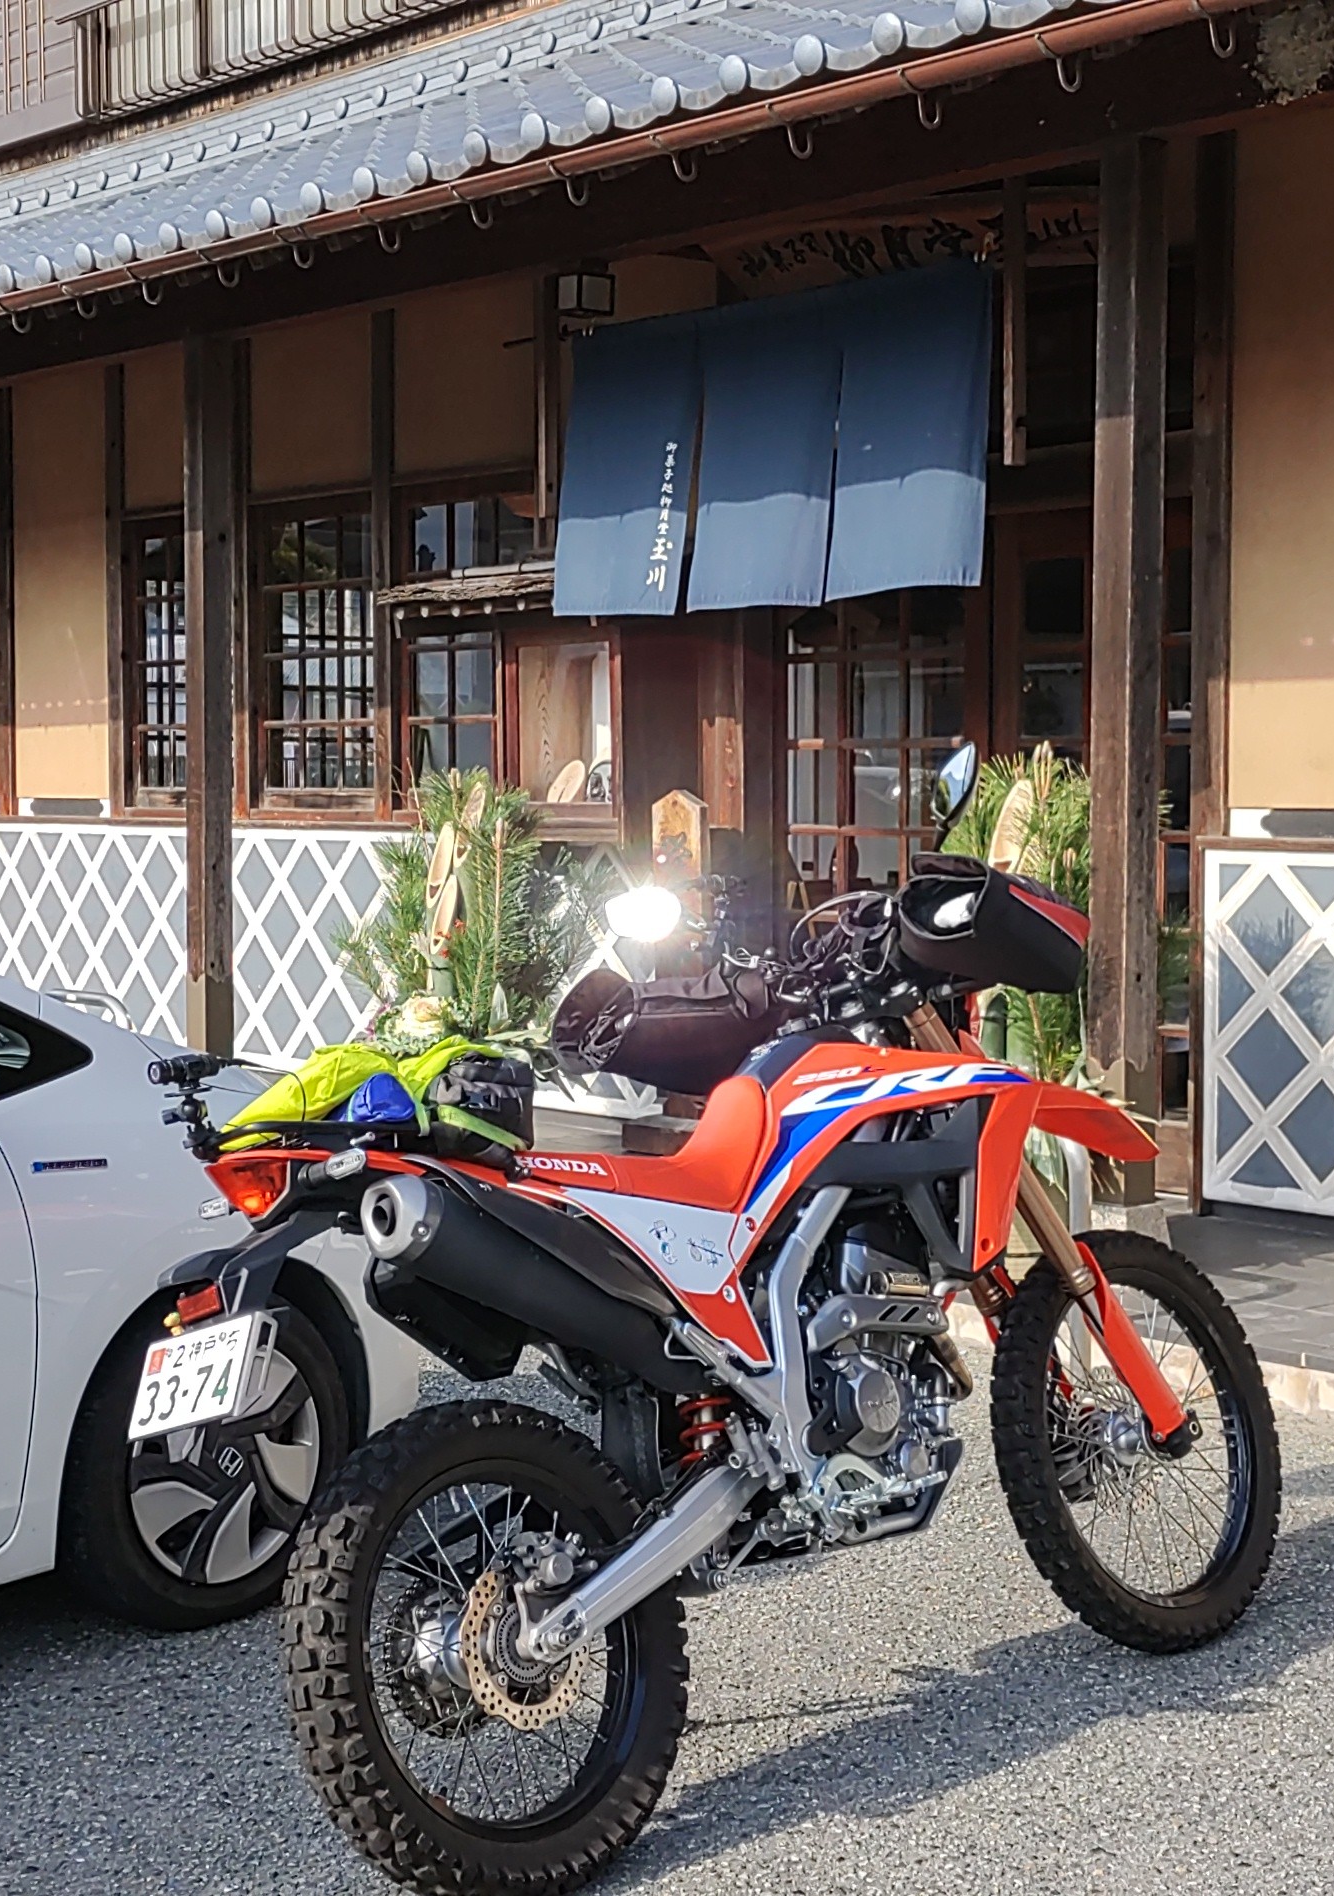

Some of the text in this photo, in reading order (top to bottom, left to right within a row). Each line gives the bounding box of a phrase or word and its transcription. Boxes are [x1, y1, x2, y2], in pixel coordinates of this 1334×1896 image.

[780, 1062, 1019, 1117] CRF
[513, 1155, 608, 1176] HONDA
[137, 1358, 234, 1427] 33-74
